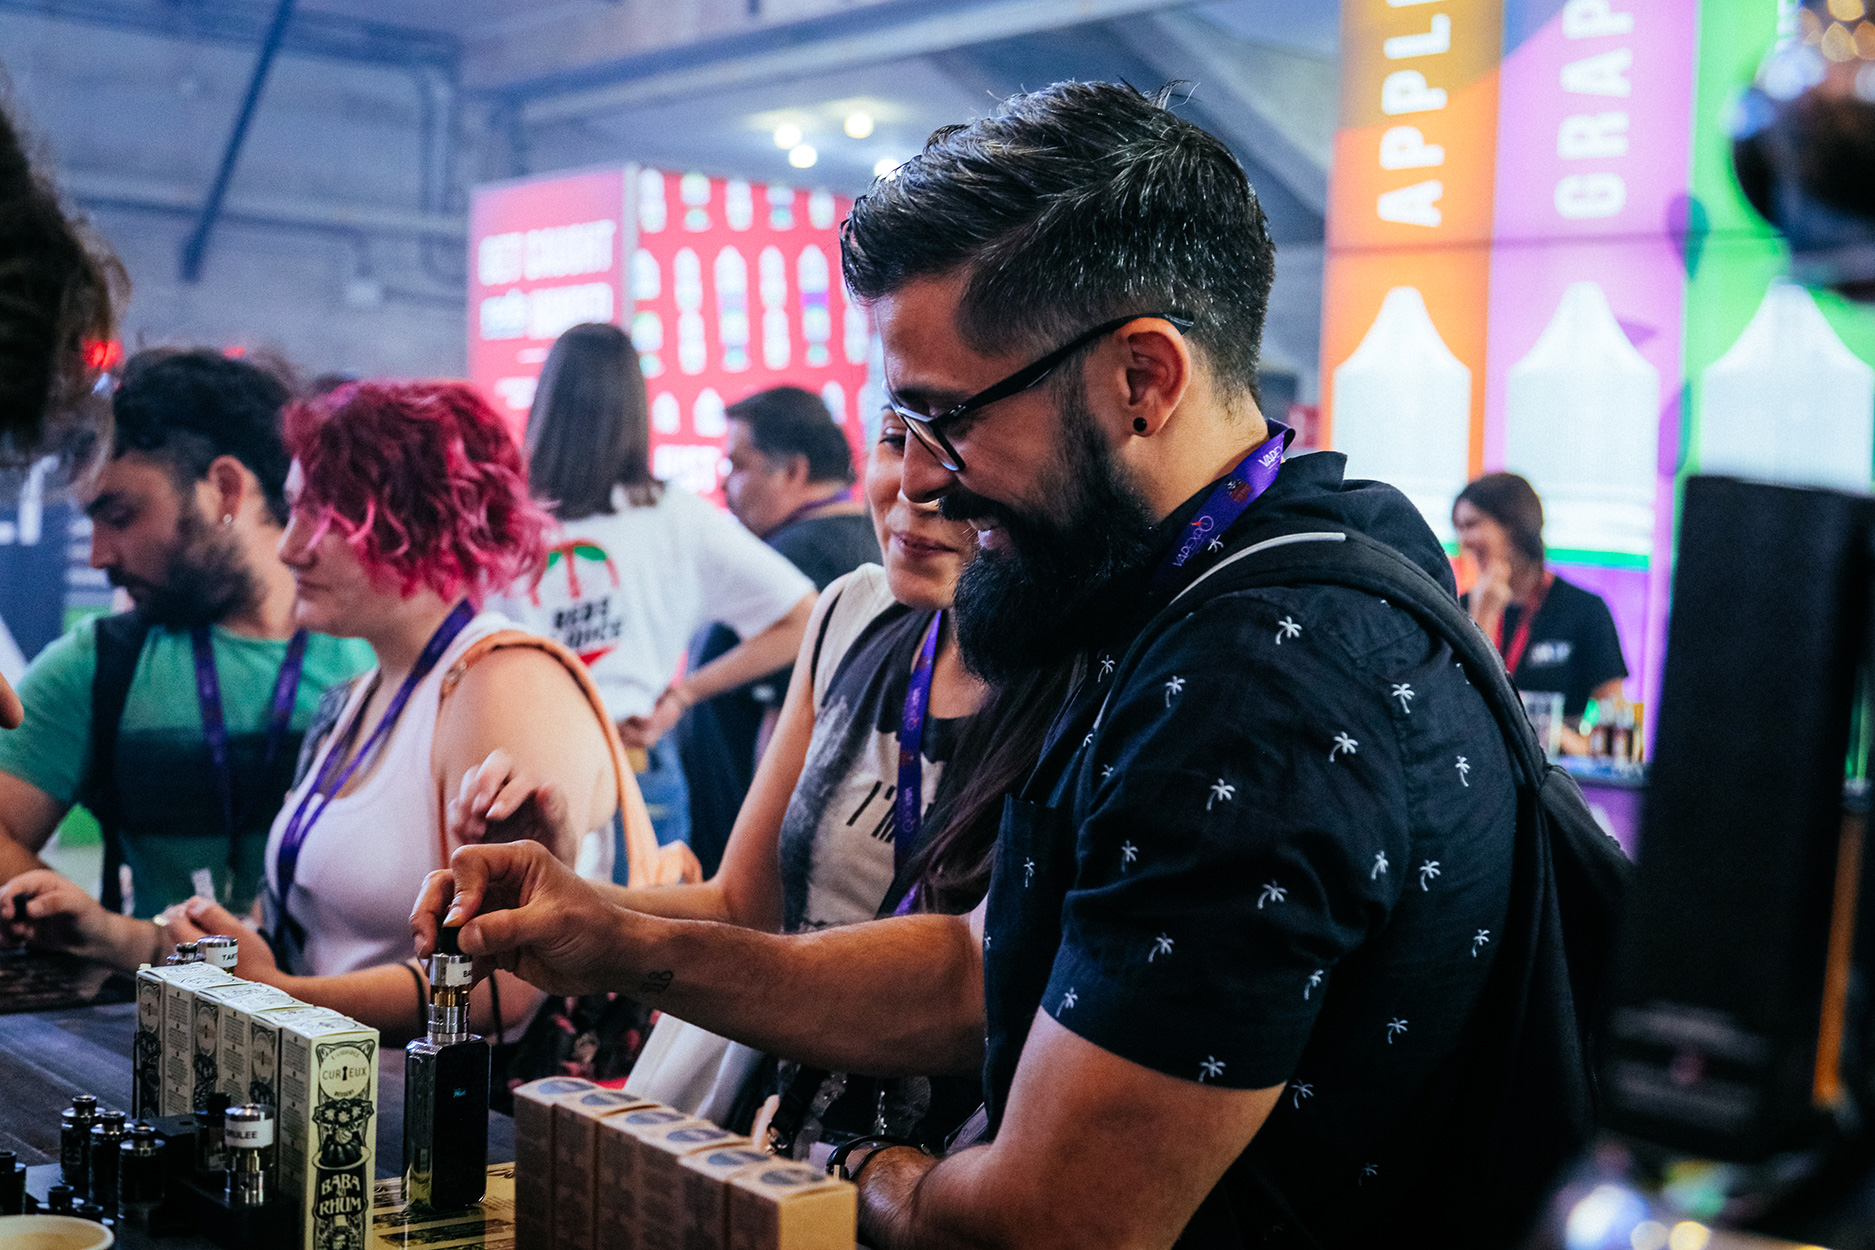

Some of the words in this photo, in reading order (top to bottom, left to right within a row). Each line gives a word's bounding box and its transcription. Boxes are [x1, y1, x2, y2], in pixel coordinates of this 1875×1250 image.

[1377, 0, 1451, 227] APPL
[1554, 0, 1634, 219] GRAP
[319, 1197, 361, 1215] RHUM
[321, 1173, 360, 1195] BABA
